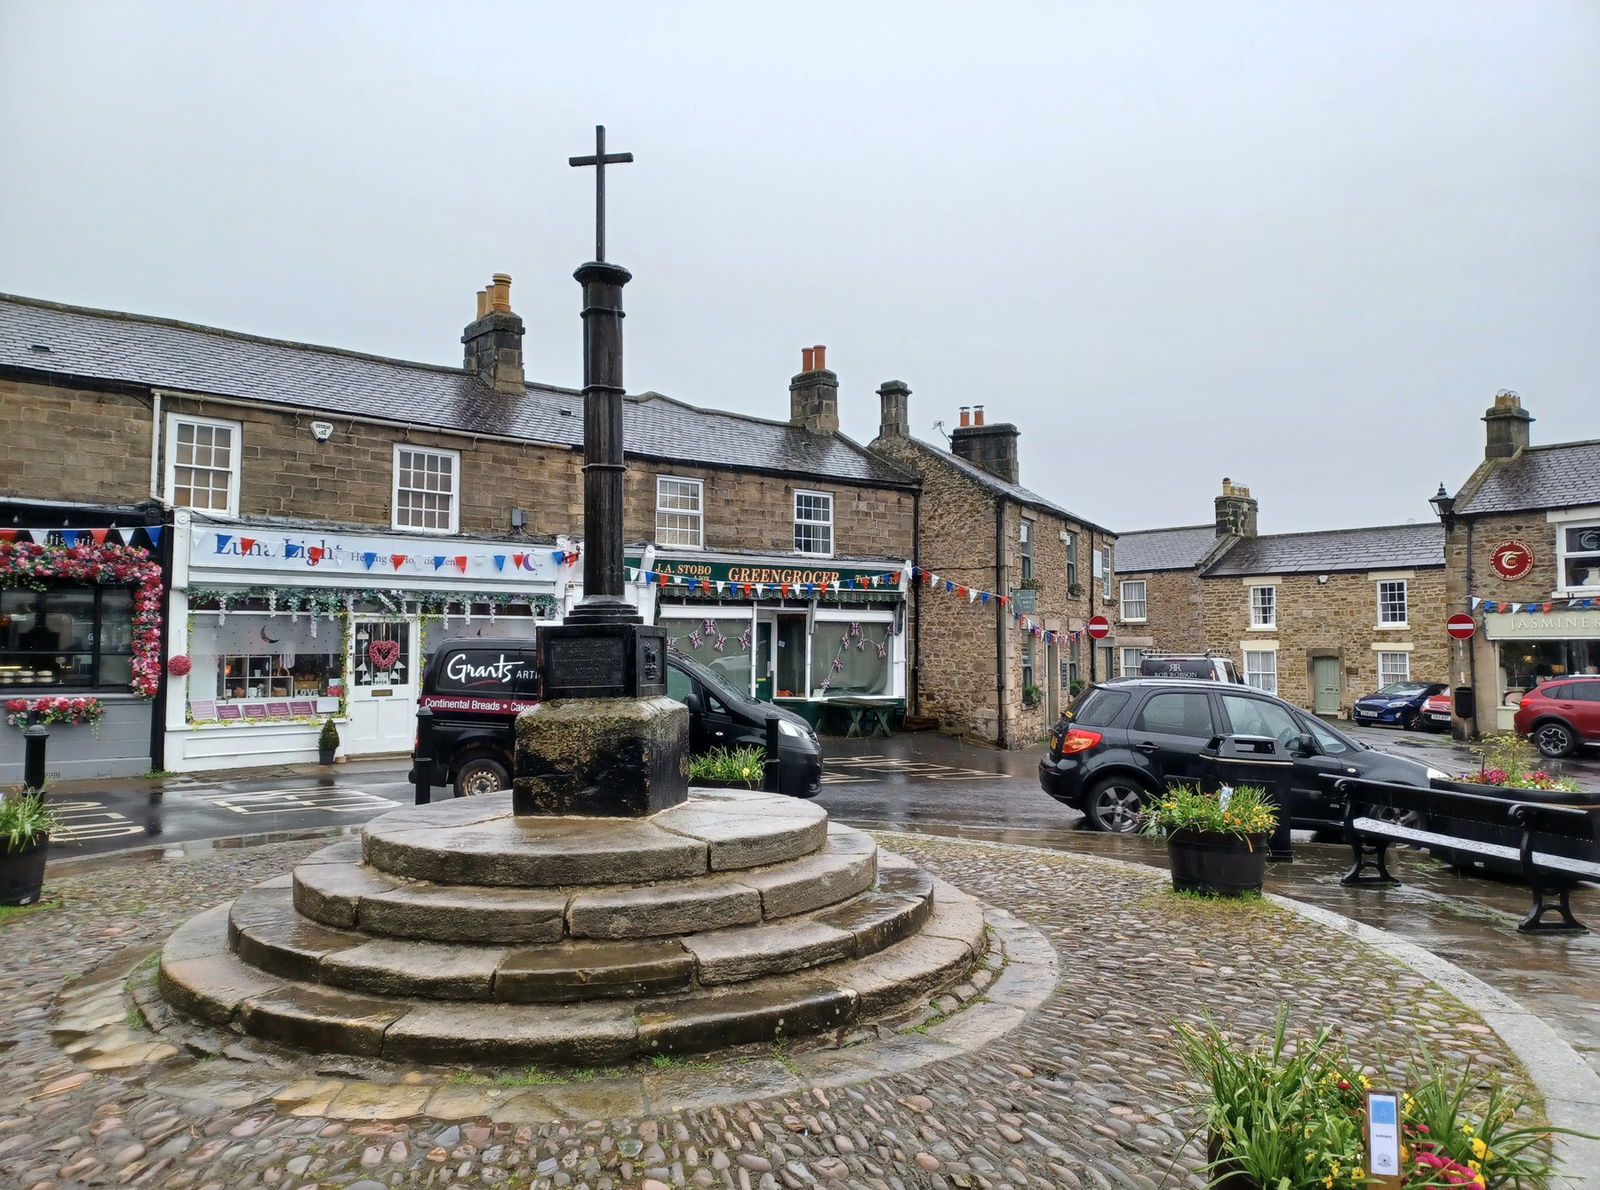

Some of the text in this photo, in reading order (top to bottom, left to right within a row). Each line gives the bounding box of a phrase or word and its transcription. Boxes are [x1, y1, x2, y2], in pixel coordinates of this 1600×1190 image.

[677, 564, 712, 575] STOBO
[728, 567, 840, 585] GREENGROCER
[447, 653, 525, 683] Grants
[294, 689, 320, 697] LOVE
[425, 697, 470, 710] Continental
[471, 700, 500, 711] Breads
